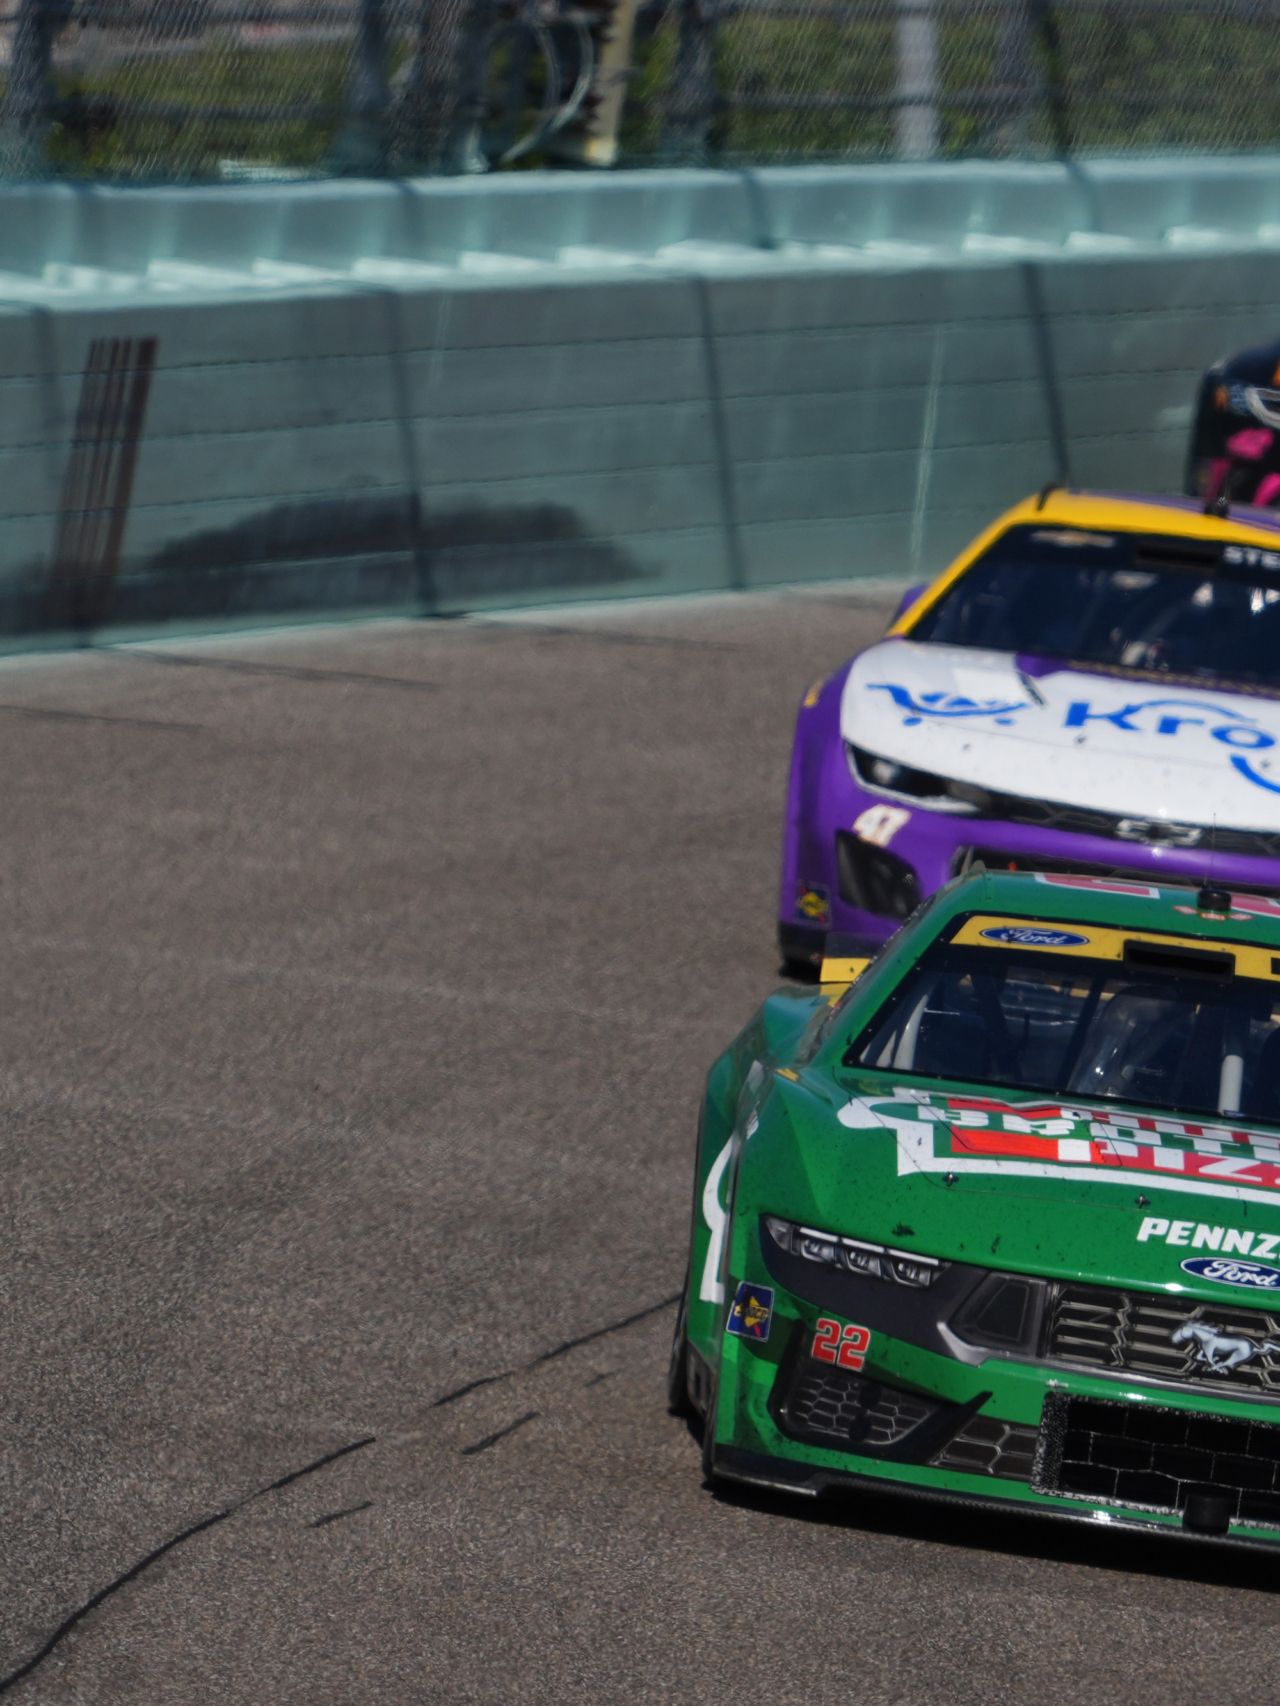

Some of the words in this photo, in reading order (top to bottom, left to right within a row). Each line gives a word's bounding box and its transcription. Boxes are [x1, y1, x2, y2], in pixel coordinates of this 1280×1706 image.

[852, 803, 912, 848] 47
[1202, 1259, 1279, 1288] Ford
[811, 1317, 871, 1373] 22
